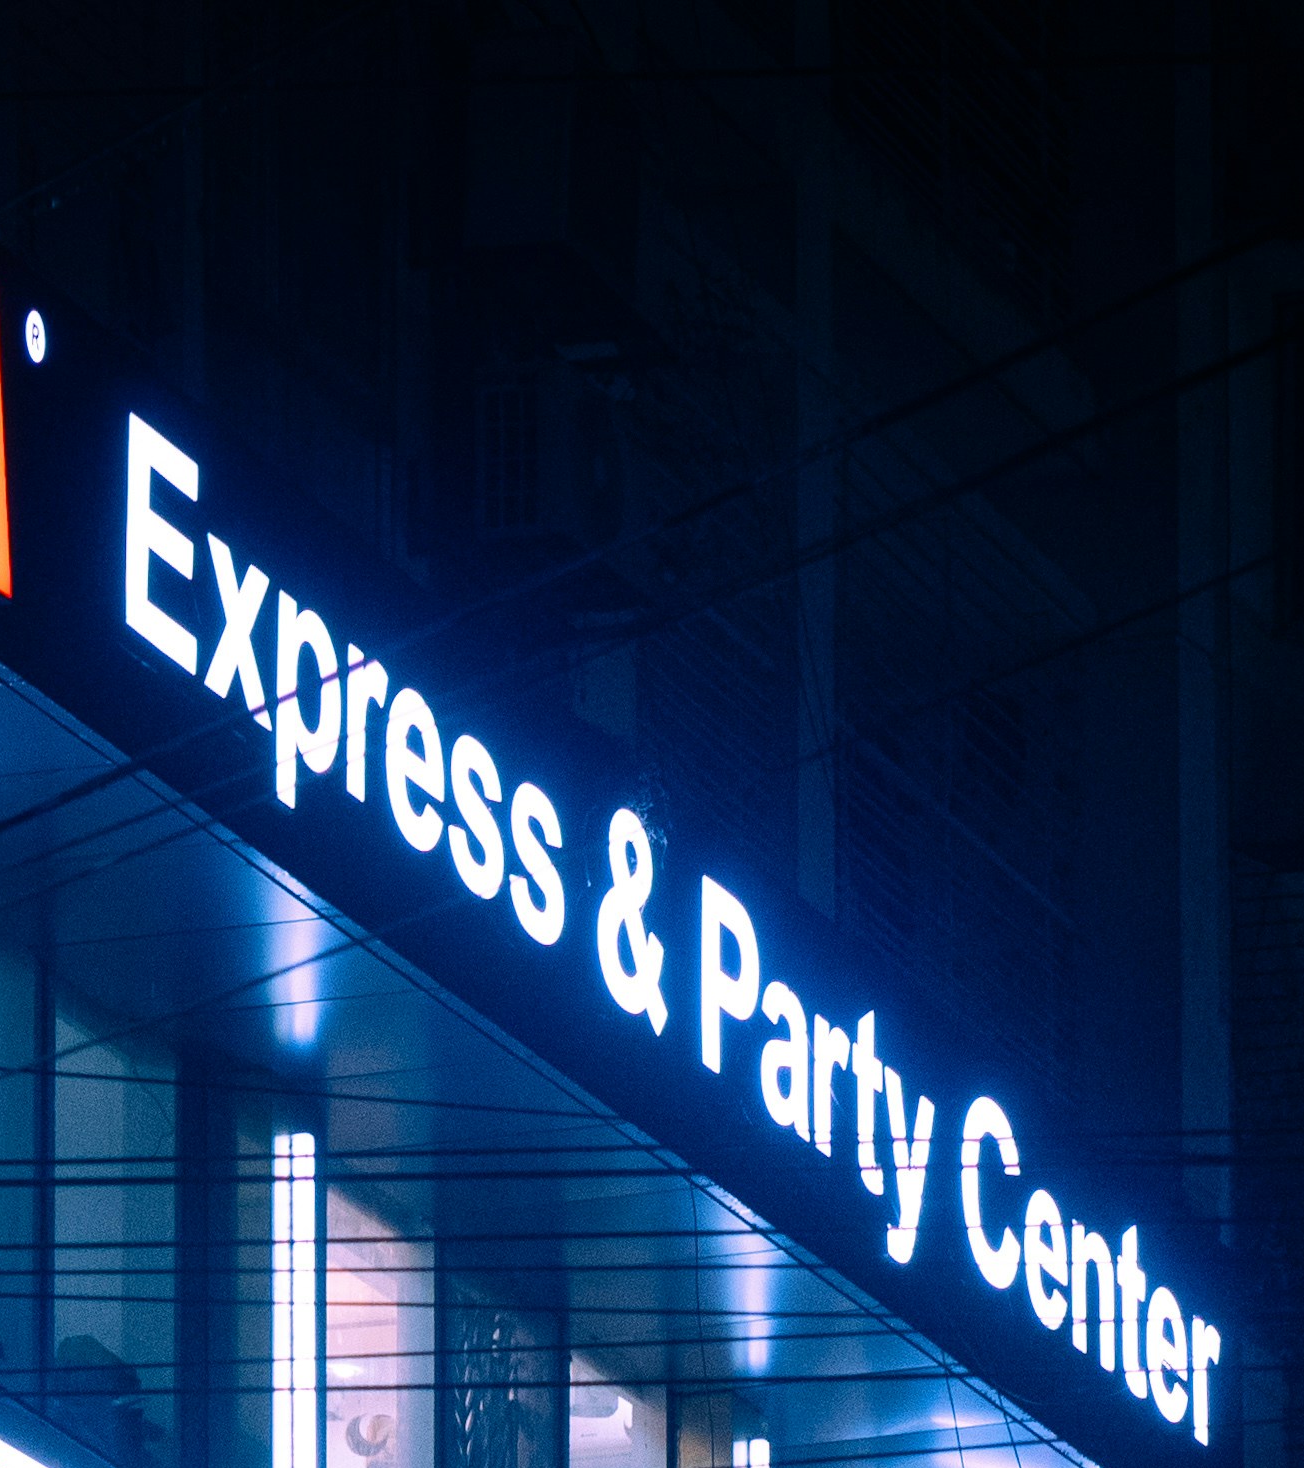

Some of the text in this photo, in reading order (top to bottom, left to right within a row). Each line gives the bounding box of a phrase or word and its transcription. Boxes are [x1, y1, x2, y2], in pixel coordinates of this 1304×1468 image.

[125, 412, 1221, 1447] Express & Party Center
